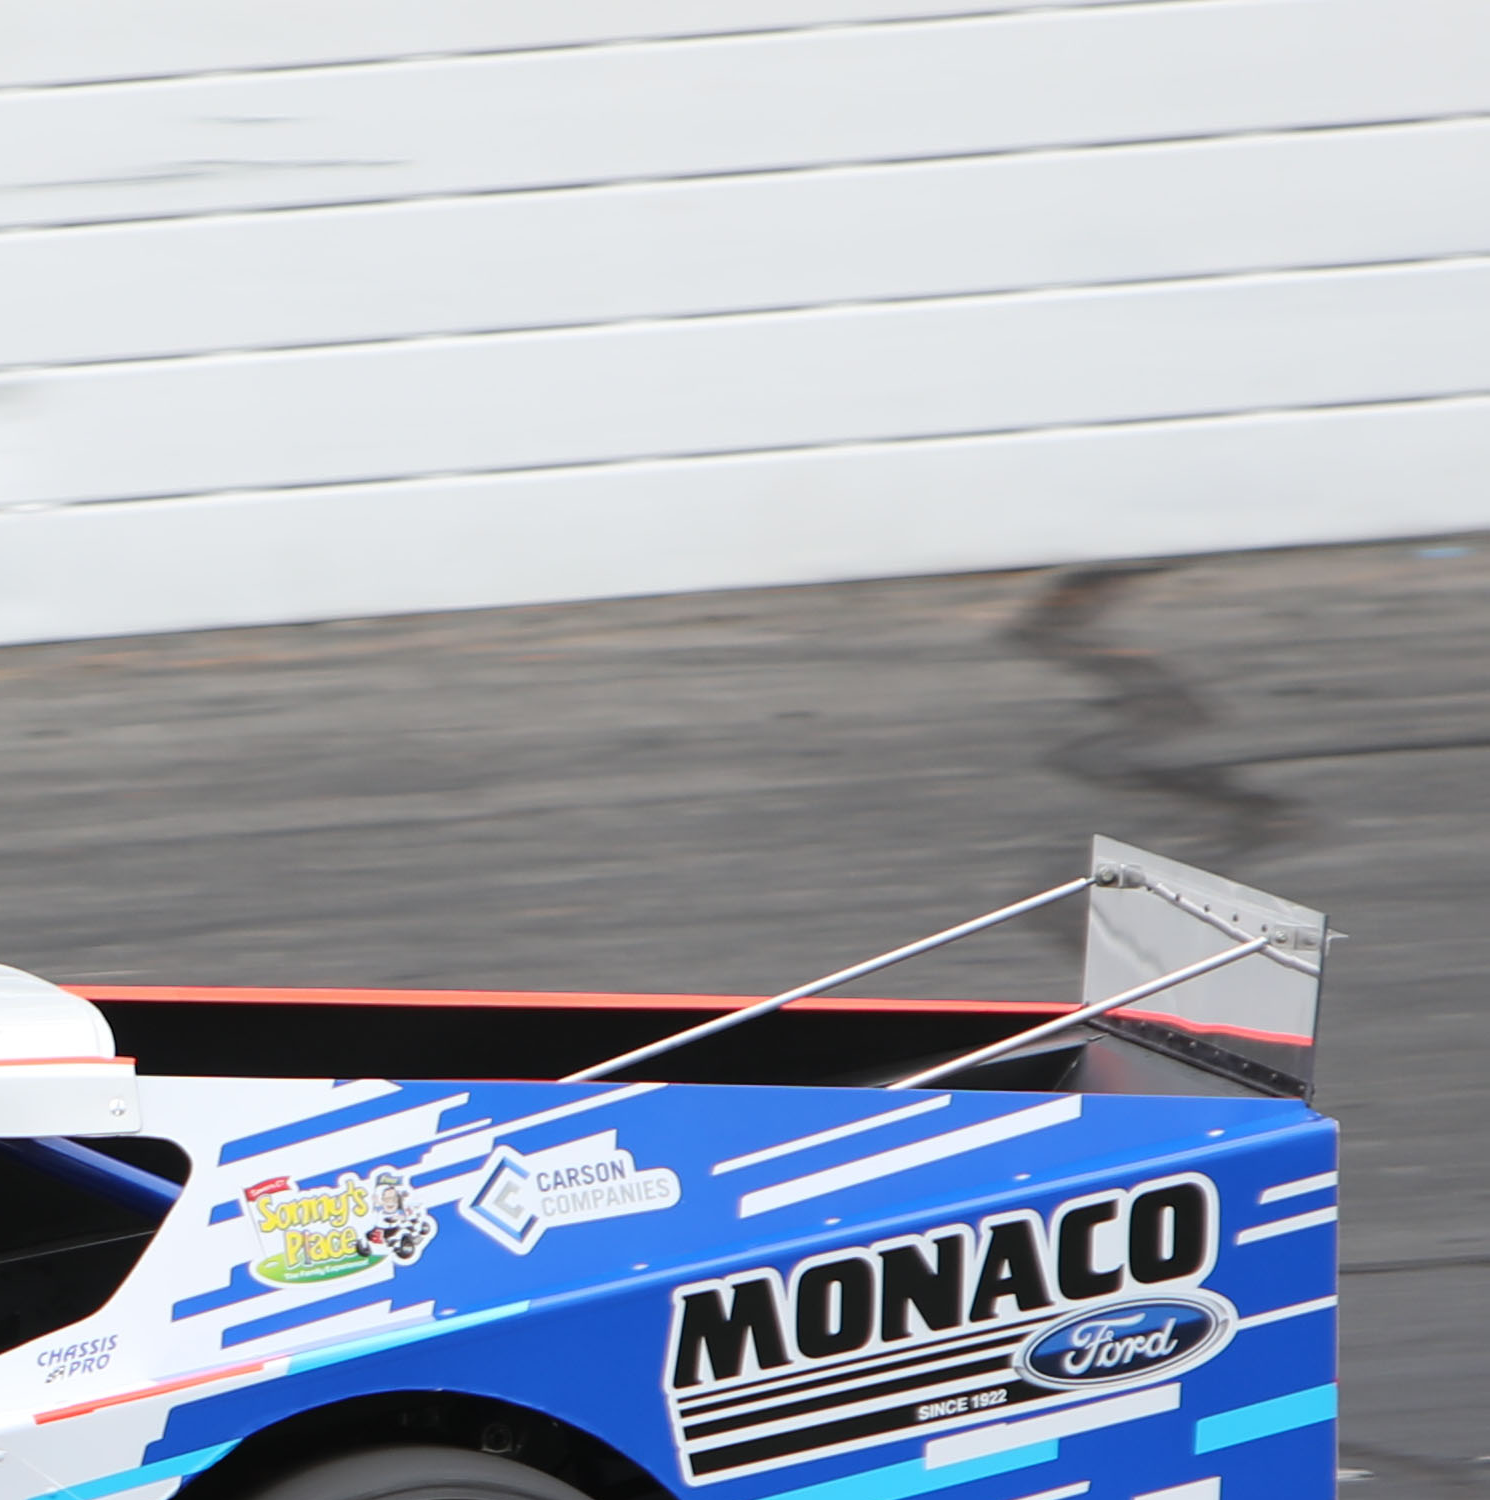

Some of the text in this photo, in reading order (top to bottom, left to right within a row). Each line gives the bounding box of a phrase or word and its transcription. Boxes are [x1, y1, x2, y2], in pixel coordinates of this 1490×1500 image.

[536, 1160, 626, 1192] CARSON
[257, 1180, 368, 1232] Sonny's
[541, 1178, 671, 1217] COMPANIES
[285, 1227, 357, 1268] Place
[671, 1180, 1210, 1391] MONACO
[37, 1334, 118, 1367] CHASSIS
[1064, 1312, 1179, 1375] Ford
[68, 1353, 111, 1377] PRO
[918, 1389, 1008, 1420] SINCE 1922
